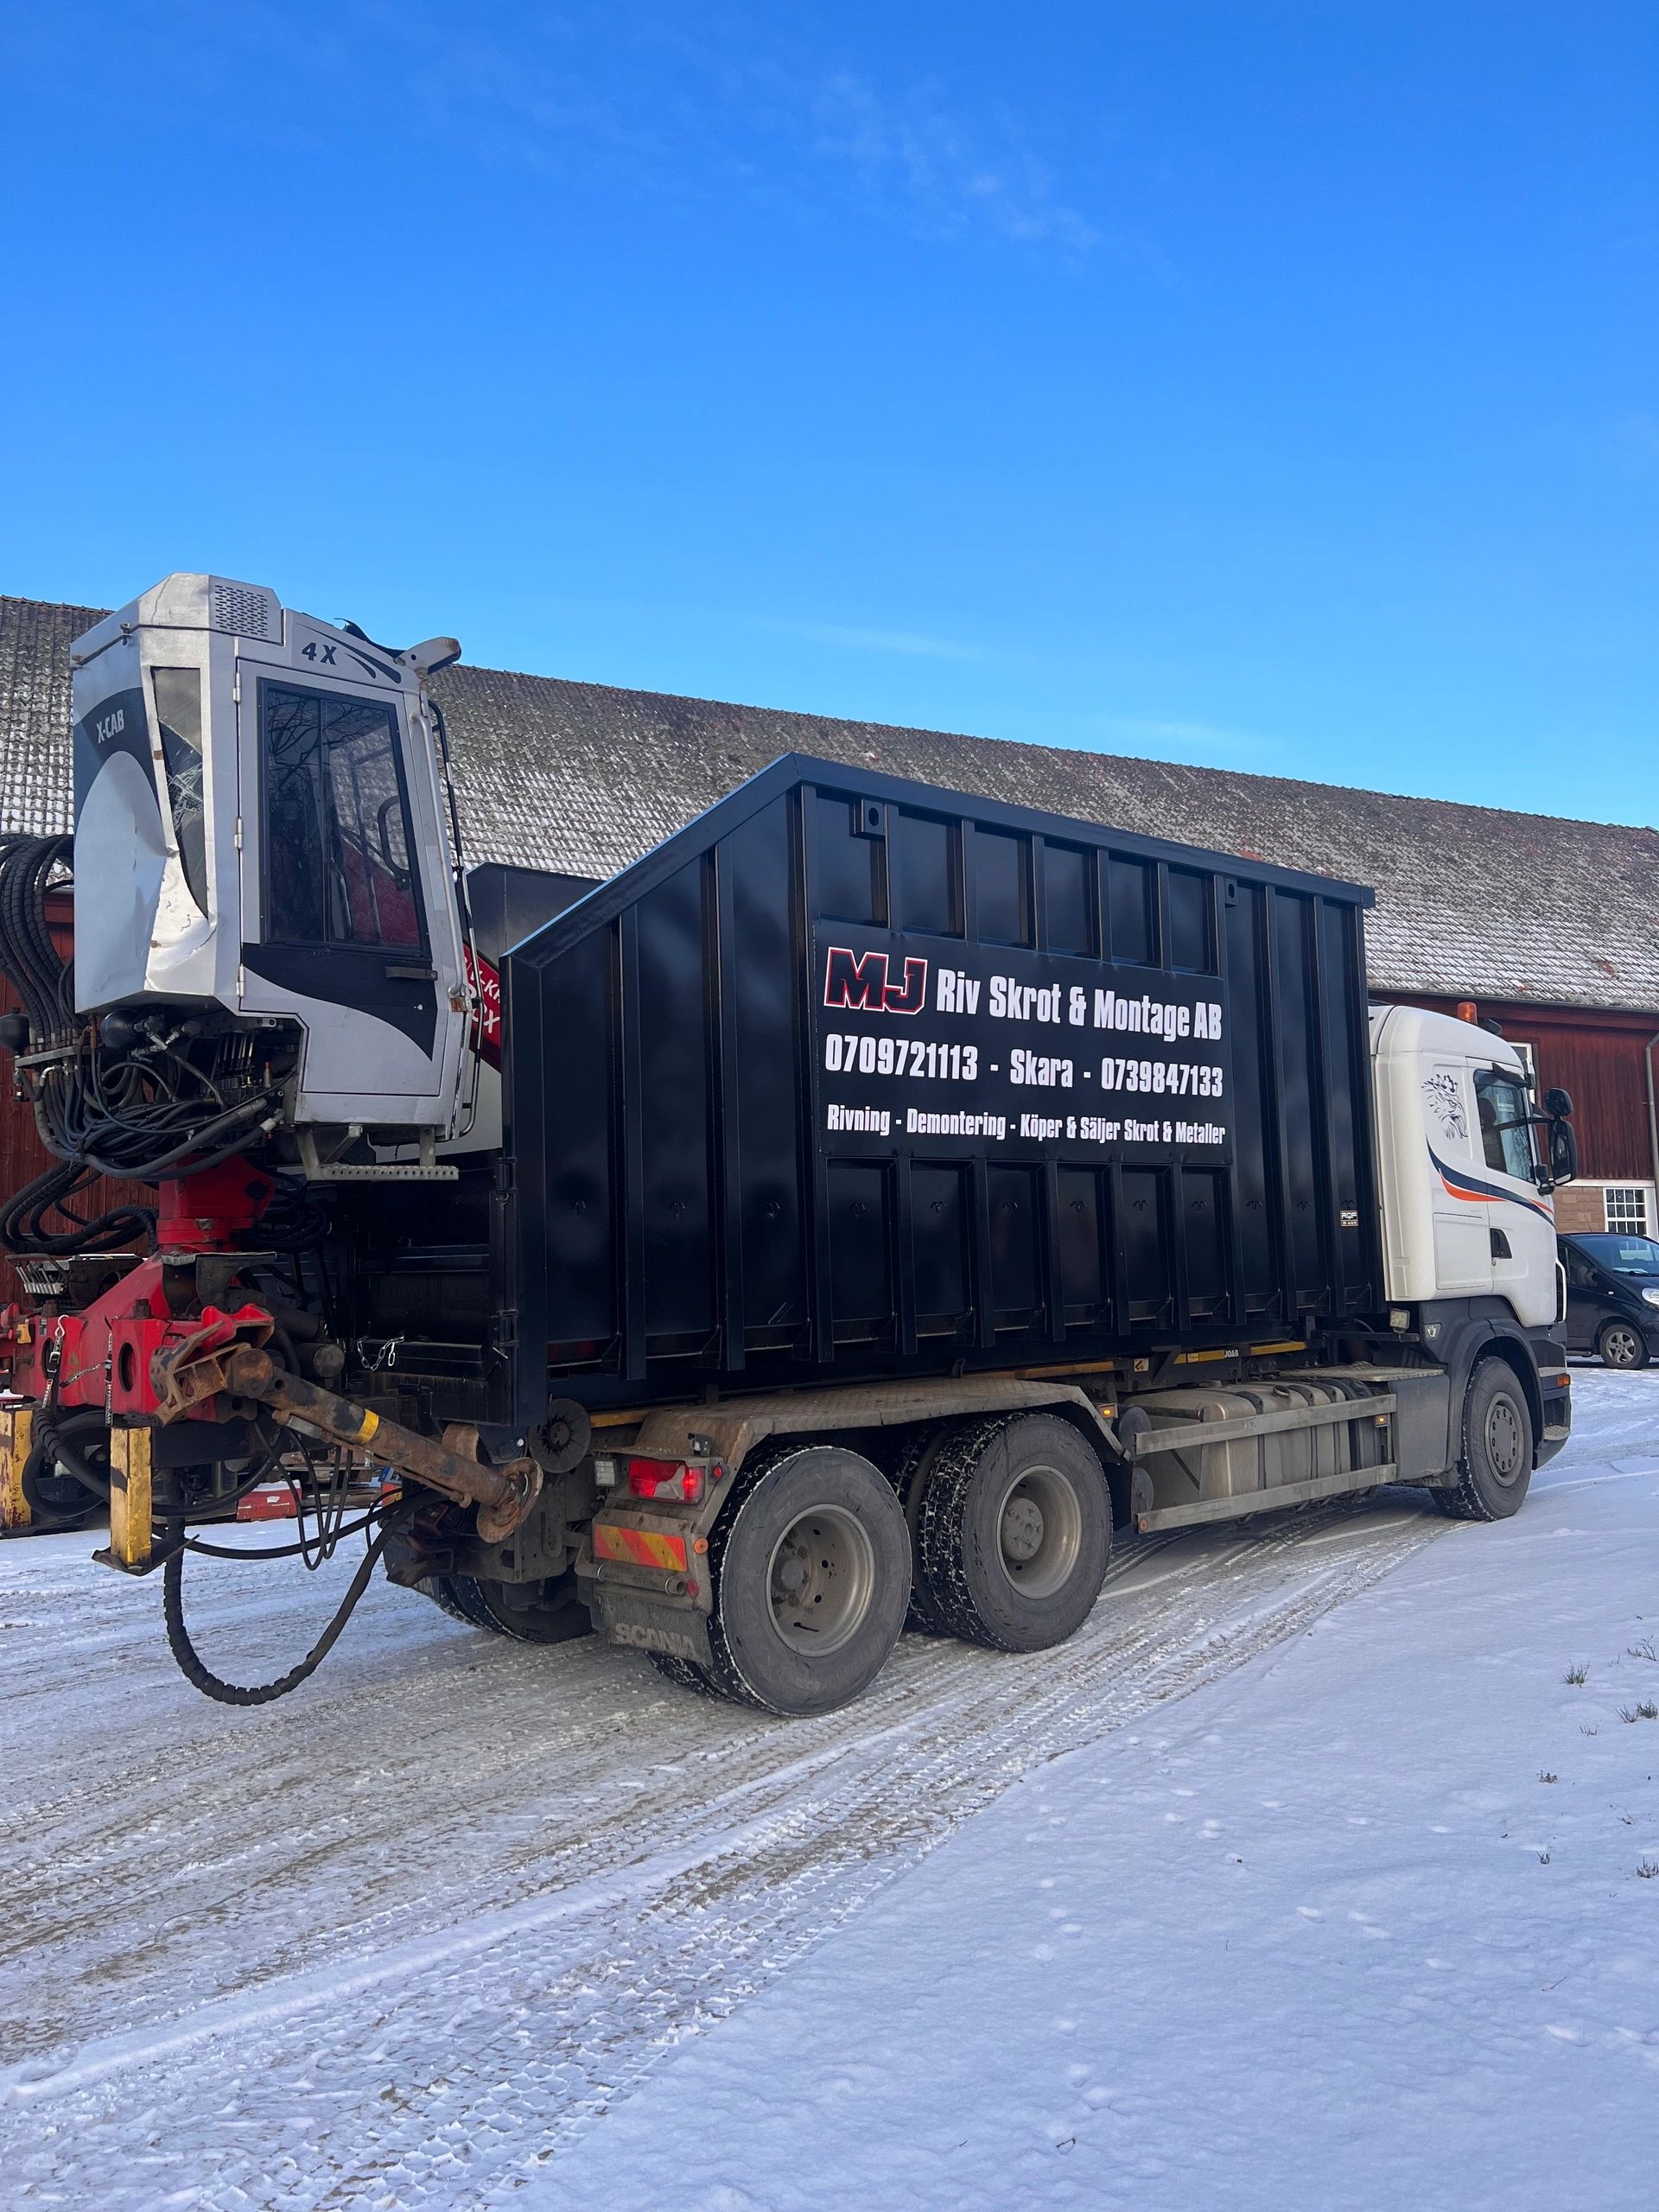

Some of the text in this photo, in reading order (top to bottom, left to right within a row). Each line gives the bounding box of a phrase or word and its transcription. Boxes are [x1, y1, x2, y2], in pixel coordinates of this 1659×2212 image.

[96, 709, 124, 744] X-CAB
[823, 947, 1222, 1042] MJ Riv Skrot & Montage AB
[825, 1033, 978, 1080] 0709721113
[1010, 1049, 1073, 1088] Skara
[1101, 1058, 1223, 1097] 0739847133
[827, 1104, 891, 1136] Rivning
[906, 1108, 1007, 1141] Demontering
[1020, 1113, 1063, 1141] Köper
[1066, 1116, 1077, 1139] &
[1080, 1116, 1121, 1144] Säljer
[1124, 1119, 1160, 1142] Skrot
[1162, 1121, 1173, 1142] &
[1175, 1122, 1226, 1145] Metaller
